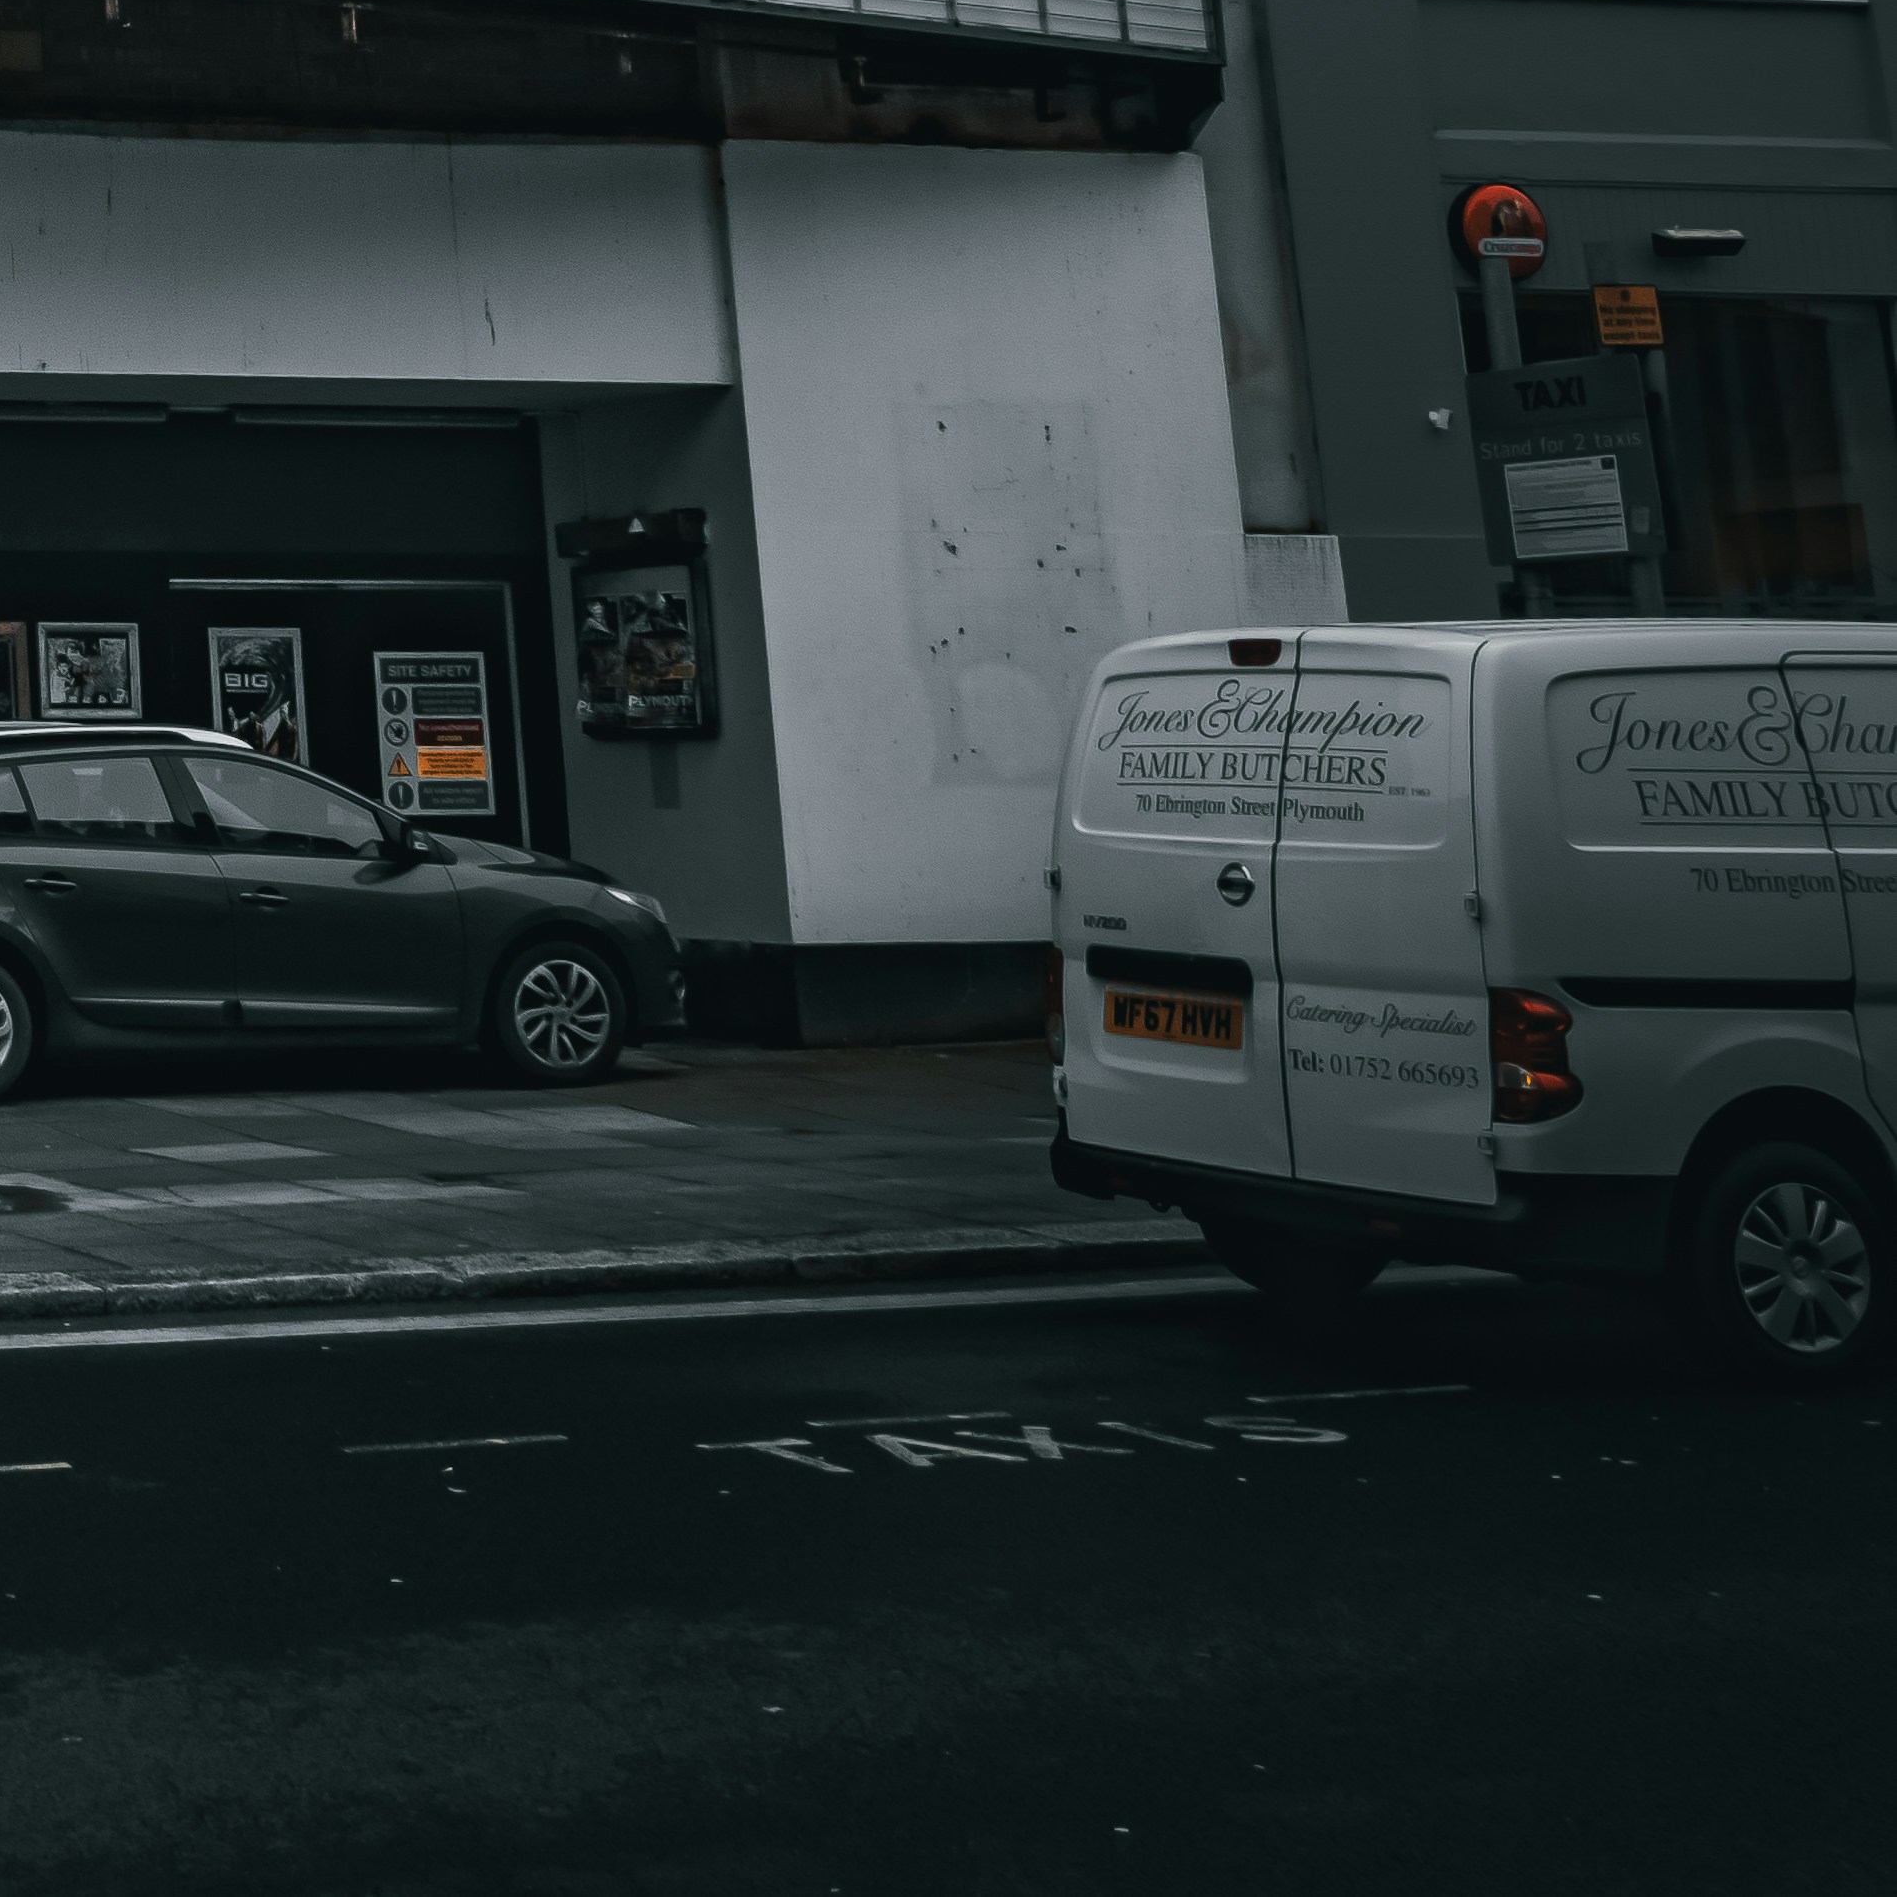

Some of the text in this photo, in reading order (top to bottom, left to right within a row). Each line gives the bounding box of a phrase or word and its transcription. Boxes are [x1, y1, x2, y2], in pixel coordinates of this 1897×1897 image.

[1514, 375, 1586, 411] TAXI
[1480, 432, 1642, 459] Stand for 2 taxis
[225, 673, 268, 688] BIG
[388, 665, 472, 678] SITE SAFETY
[1098, 679, 1433, 754] Jones & Champion
[1576, 691, 1731, 774] Jones
[1737, 685, 1791, 767] &
[1119, 751, 1388, 786] FAMILY BUTCHERS
[1135, 794, 1365, 823] 70 Ebrington Street Plymouth
[1632, 779, 1788, 818] FAMILY
[1690, 868, 1718, 892] 70
[1725, 867, 1836, 900] Ebrington
[1182, 1001, 1231, 1040] HVH
[1287, 995, 1477, 1038] Catering Specialist
[1288, 1048, 1479, 1089] Tel: 01752 665693
[695, 1416, 1350, 1473] TAXIS
